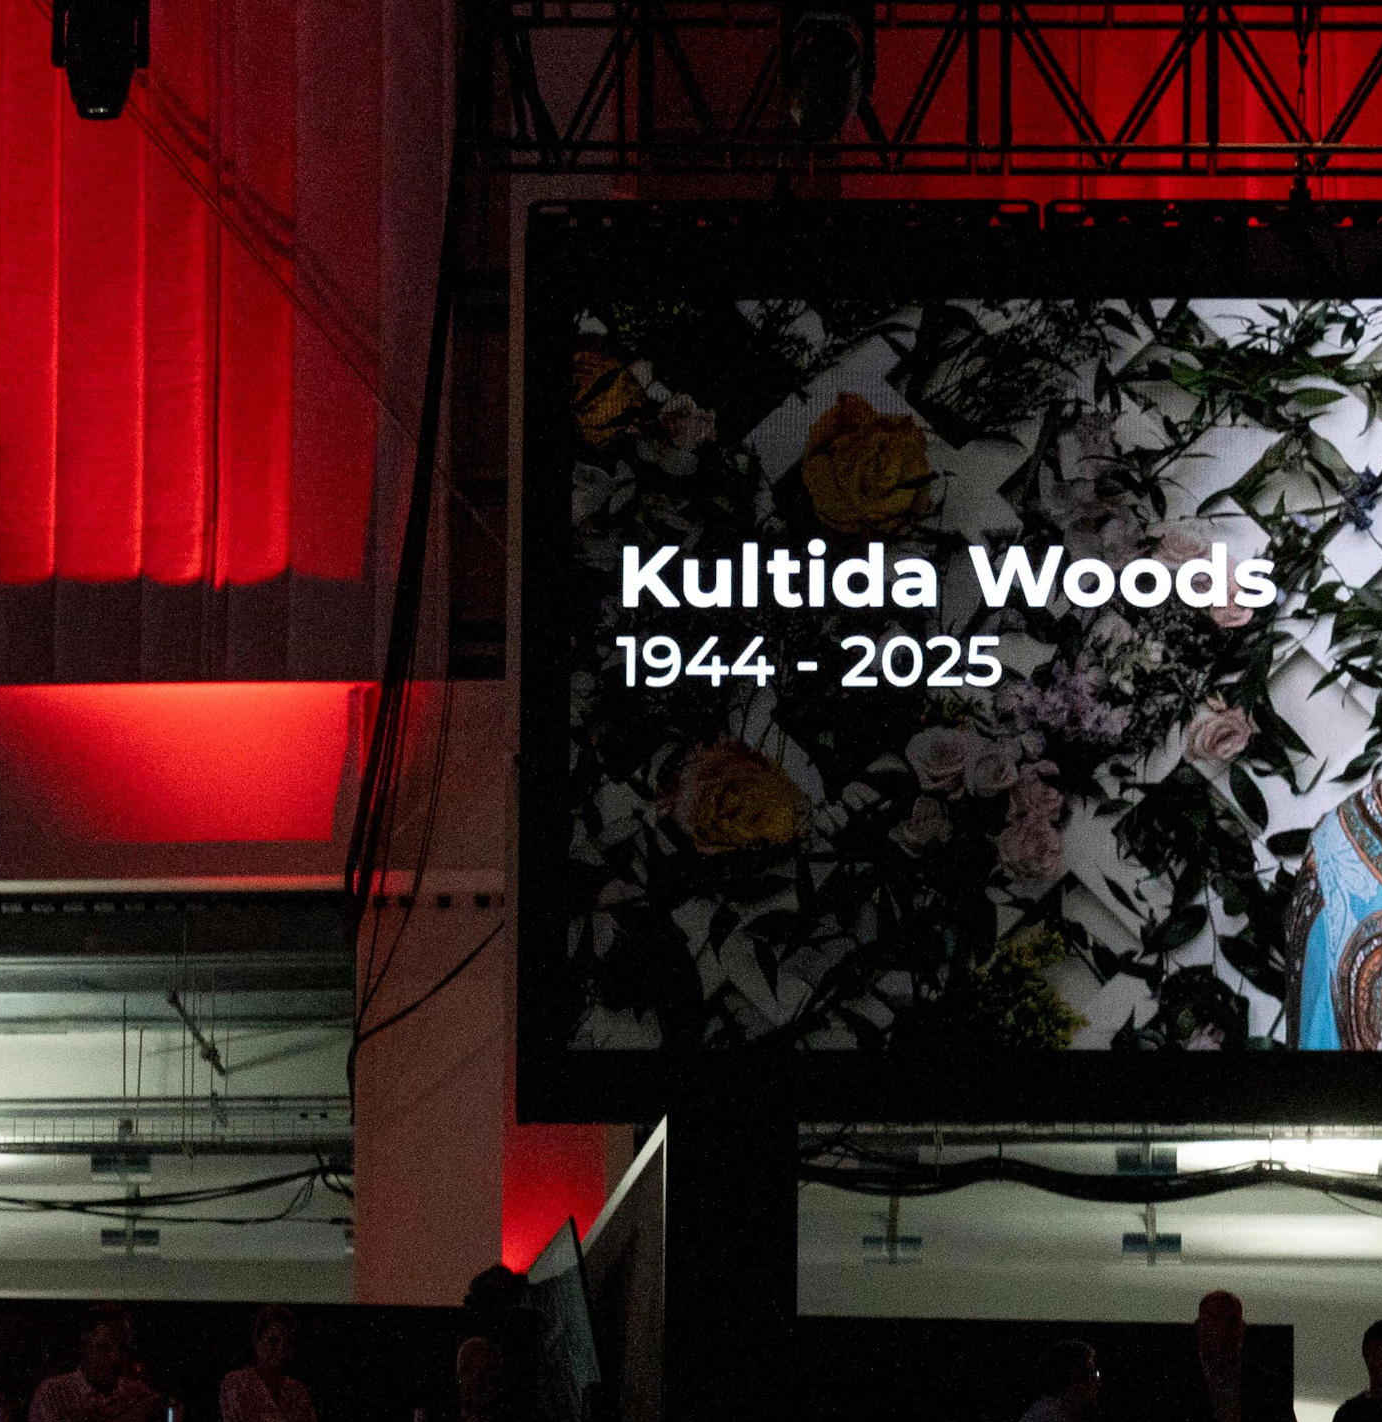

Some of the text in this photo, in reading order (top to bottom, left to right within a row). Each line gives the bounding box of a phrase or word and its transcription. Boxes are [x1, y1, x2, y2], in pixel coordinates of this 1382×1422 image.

[621, 539, 1278, 608] Kultida Woods
[616, 635, 775, 688] 1944
[840, 635, 1003, 688] 2025
